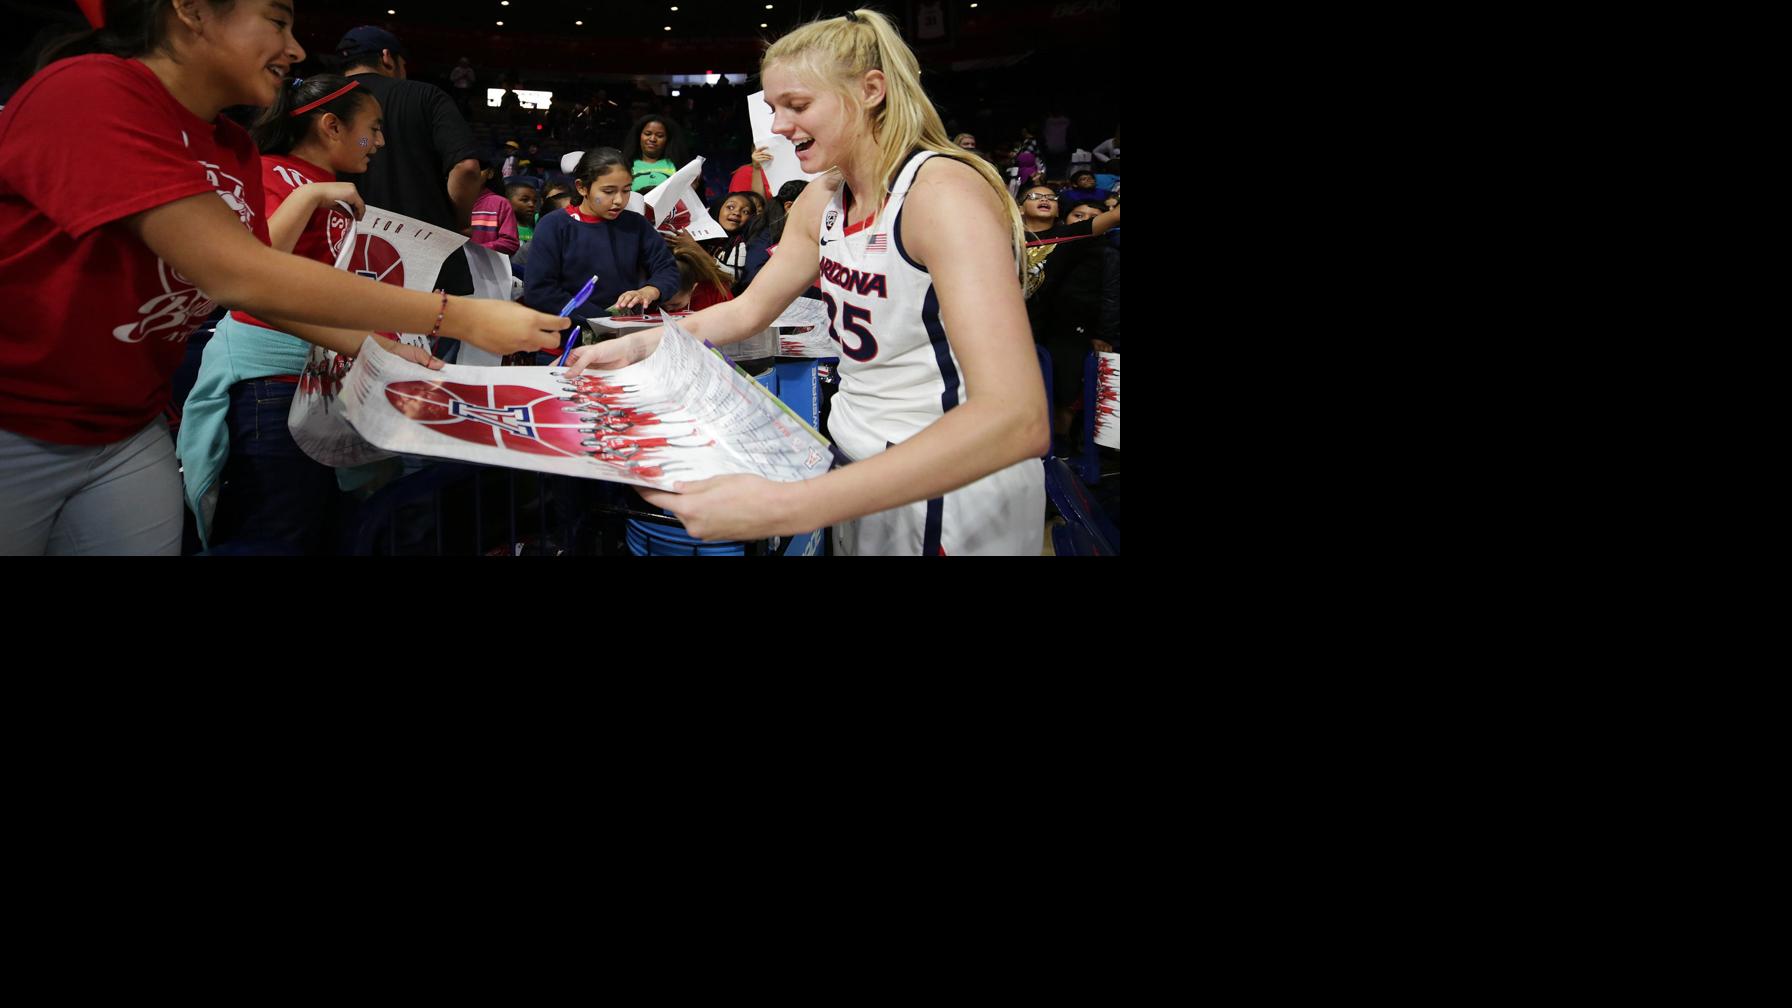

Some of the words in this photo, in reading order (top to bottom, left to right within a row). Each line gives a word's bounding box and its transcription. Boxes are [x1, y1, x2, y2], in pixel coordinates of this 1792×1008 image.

[372, 217, 404, 233] FOR
[413, 229, 433, 241] IT
[820, 255, 888, 299] ARIZONA
